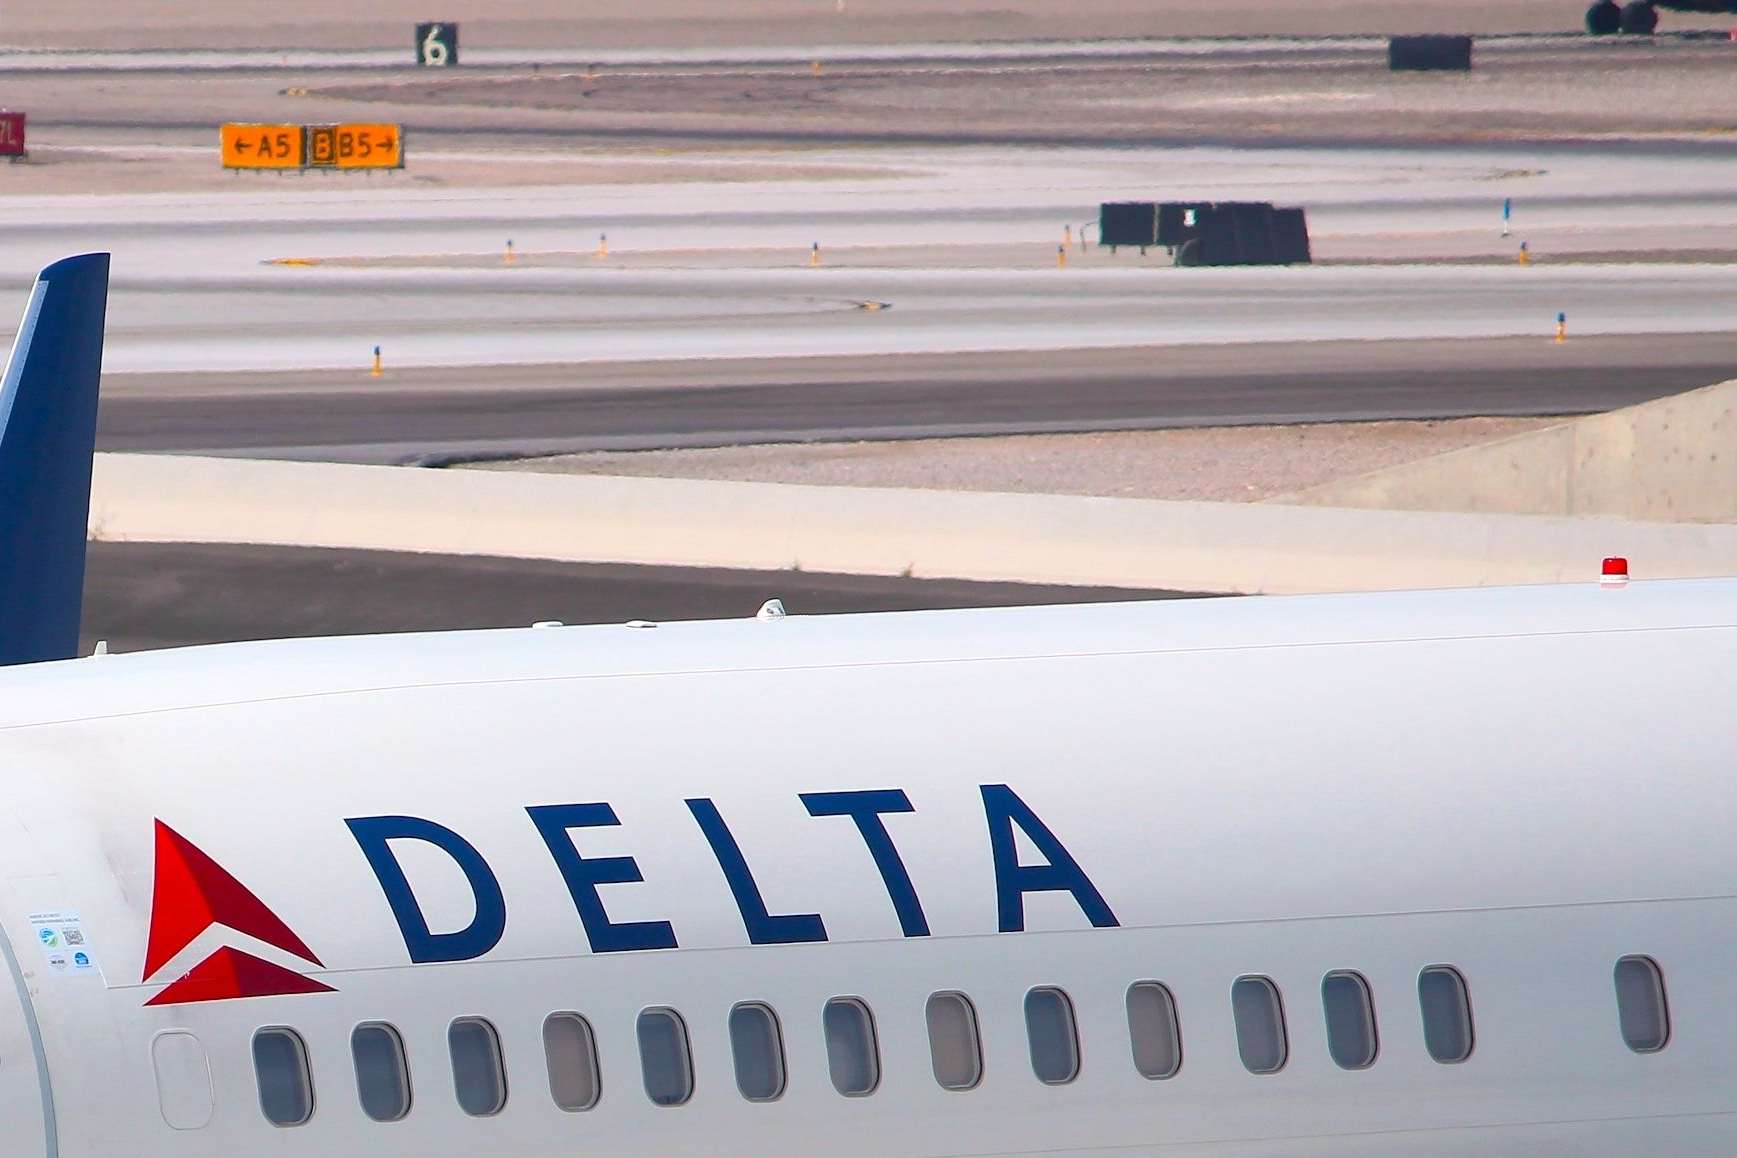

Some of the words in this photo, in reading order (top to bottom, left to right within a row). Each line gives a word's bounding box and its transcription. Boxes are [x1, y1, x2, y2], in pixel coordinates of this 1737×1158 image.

[423, 24, 447, 66] 6
[257, 134, 291, 158] A5
[339, 132, 372, 158] B5
[344, 783, 1122, 964] DELTA
